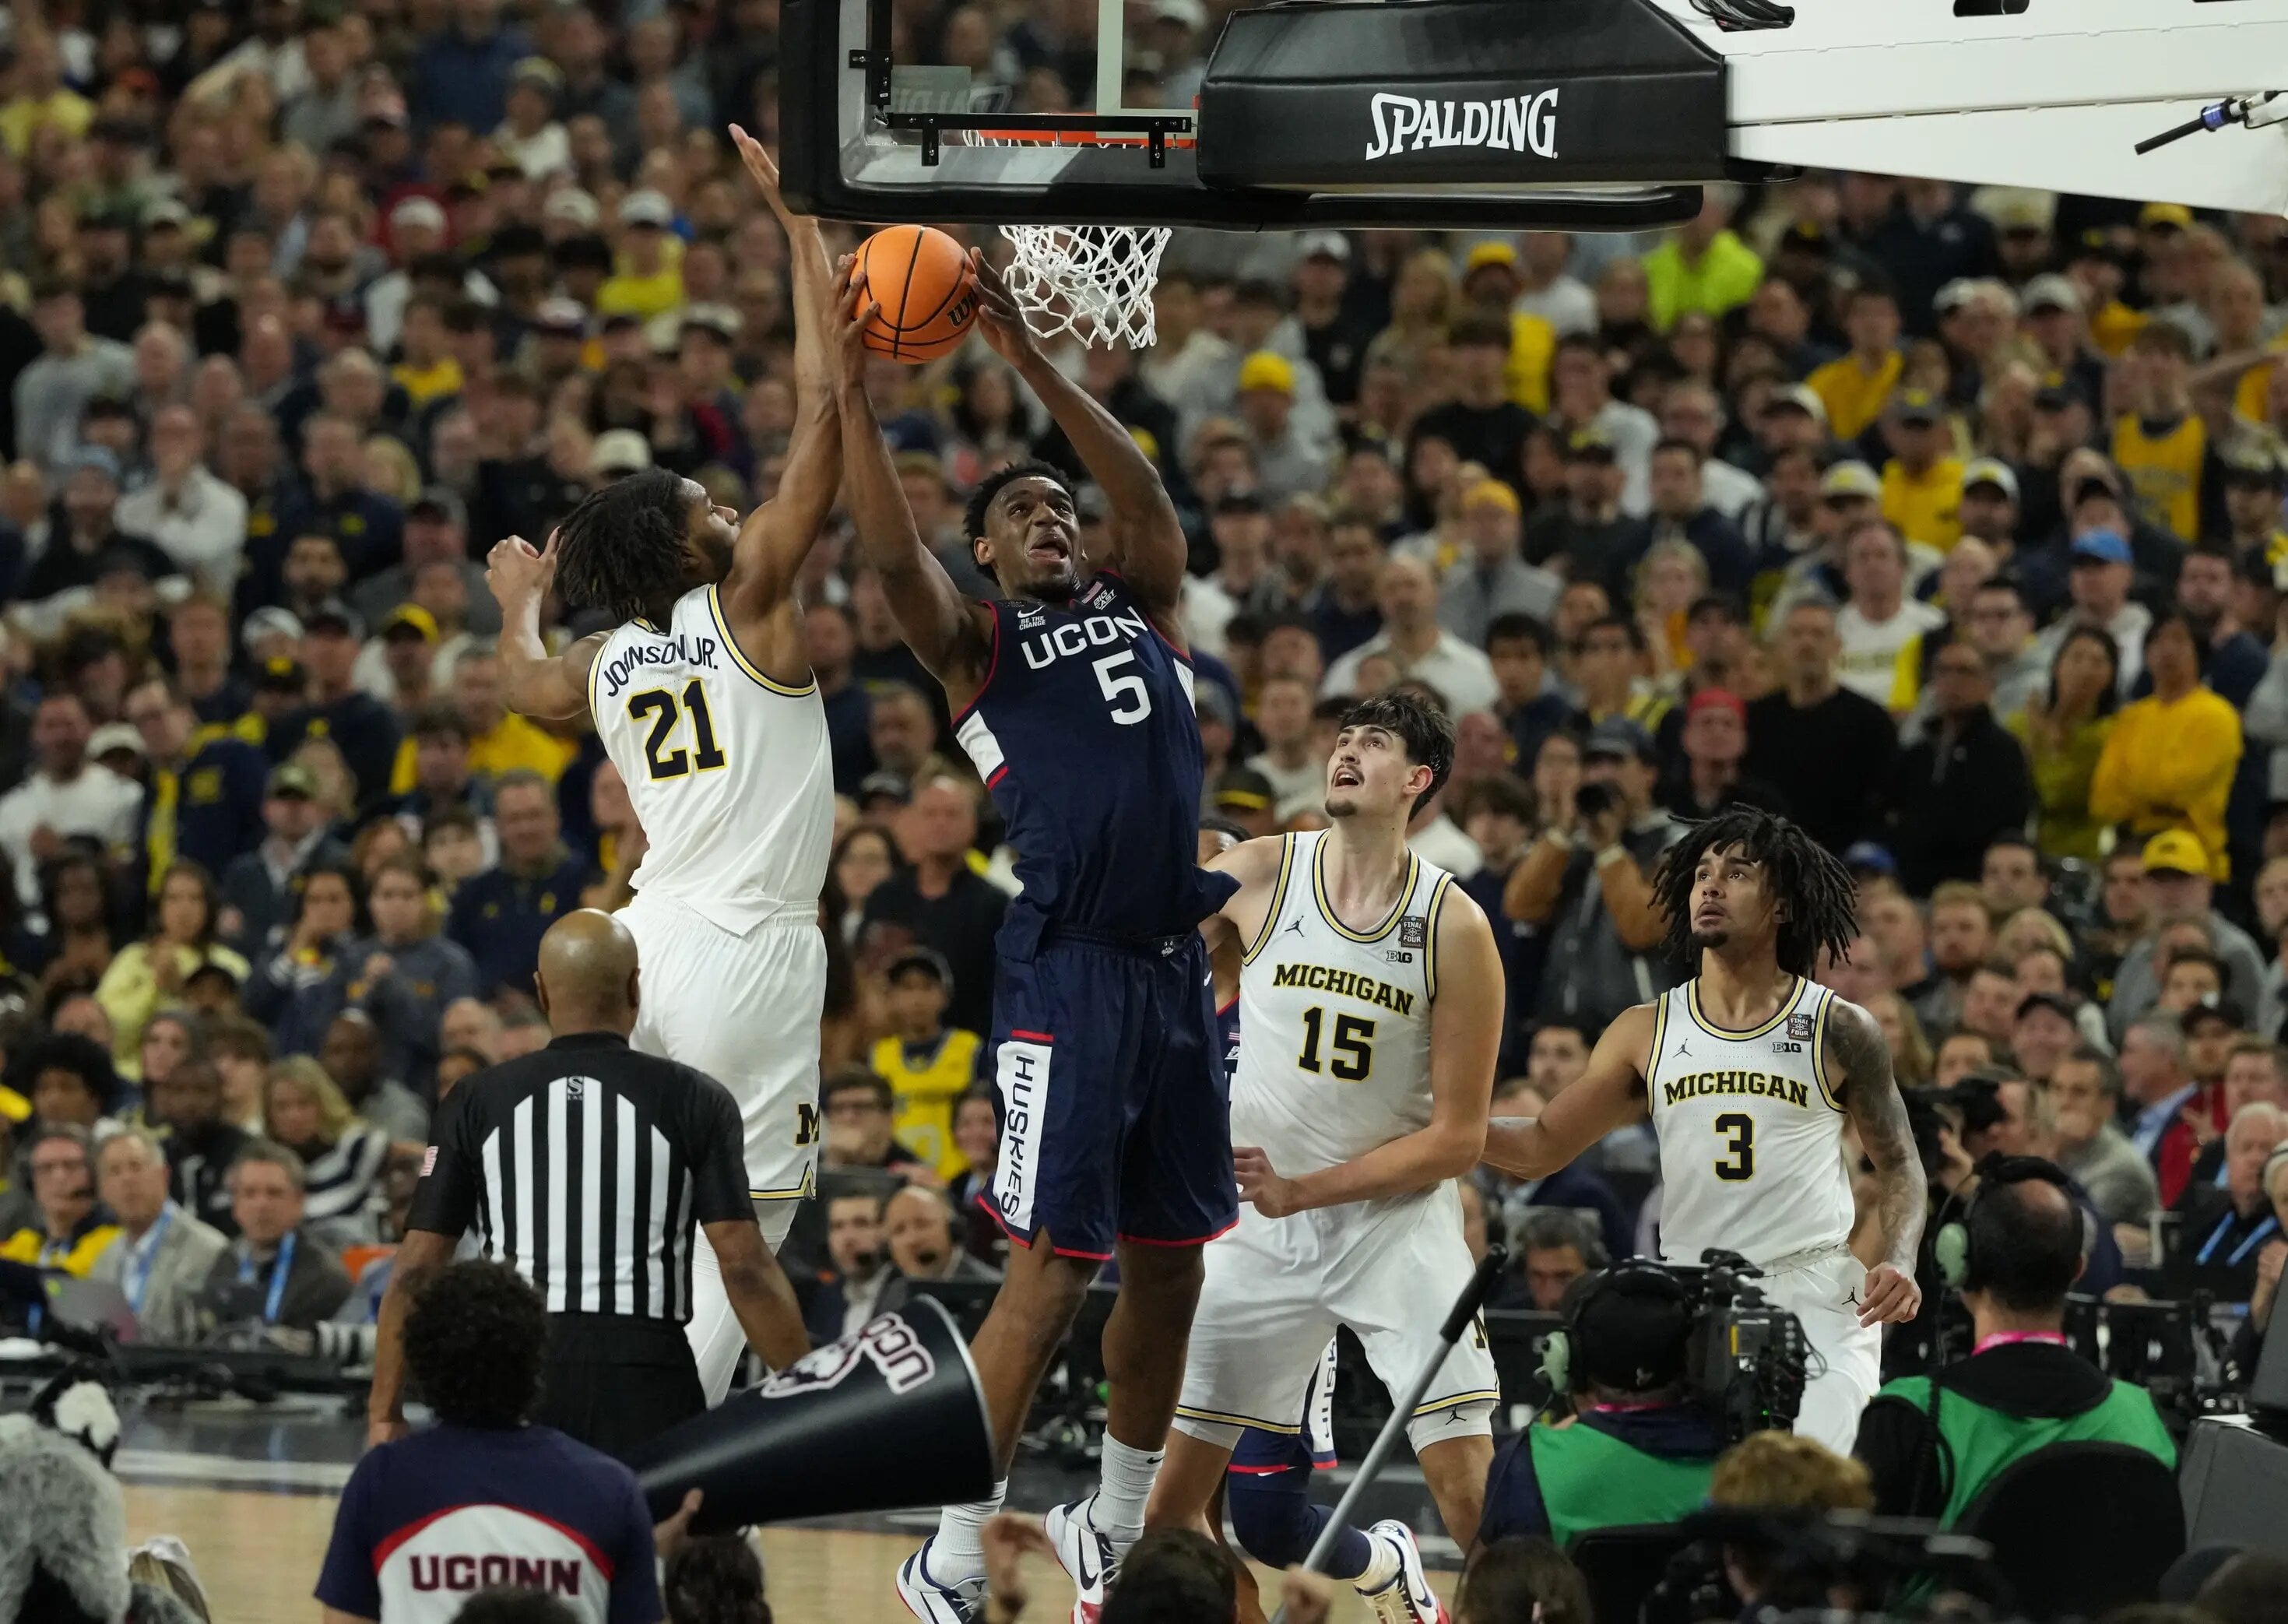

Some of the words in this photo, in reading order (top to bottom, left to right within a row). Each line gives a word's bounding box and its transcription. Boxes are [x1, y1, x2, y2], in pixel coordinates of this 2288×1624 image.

[1365, 88, 1559, 160] SPALDING
[1093, 589, 1108, 606] BIG
[1095, 589, 1116, 609] EAST
[1019, 620, 1046, 631] CHANGE
[689, 637, 719, 670] JR.
[1092, 649, 1151, 725] 5
[626, 677, 727, 782] 21
[1403, 921, 1422, 930] FINAL
[1273, 964, 1415, 1016] MICHIGAN
[1299, 1006, 1376, 1082] 15
[1664, 1070, 1808, 1108] MICHIGAN
[1000, 1055, 1035, 1217] HUSKIES
[1715, 1113, 1754, 1181] 3
[409, 1555, 582, 1596] UCONN
